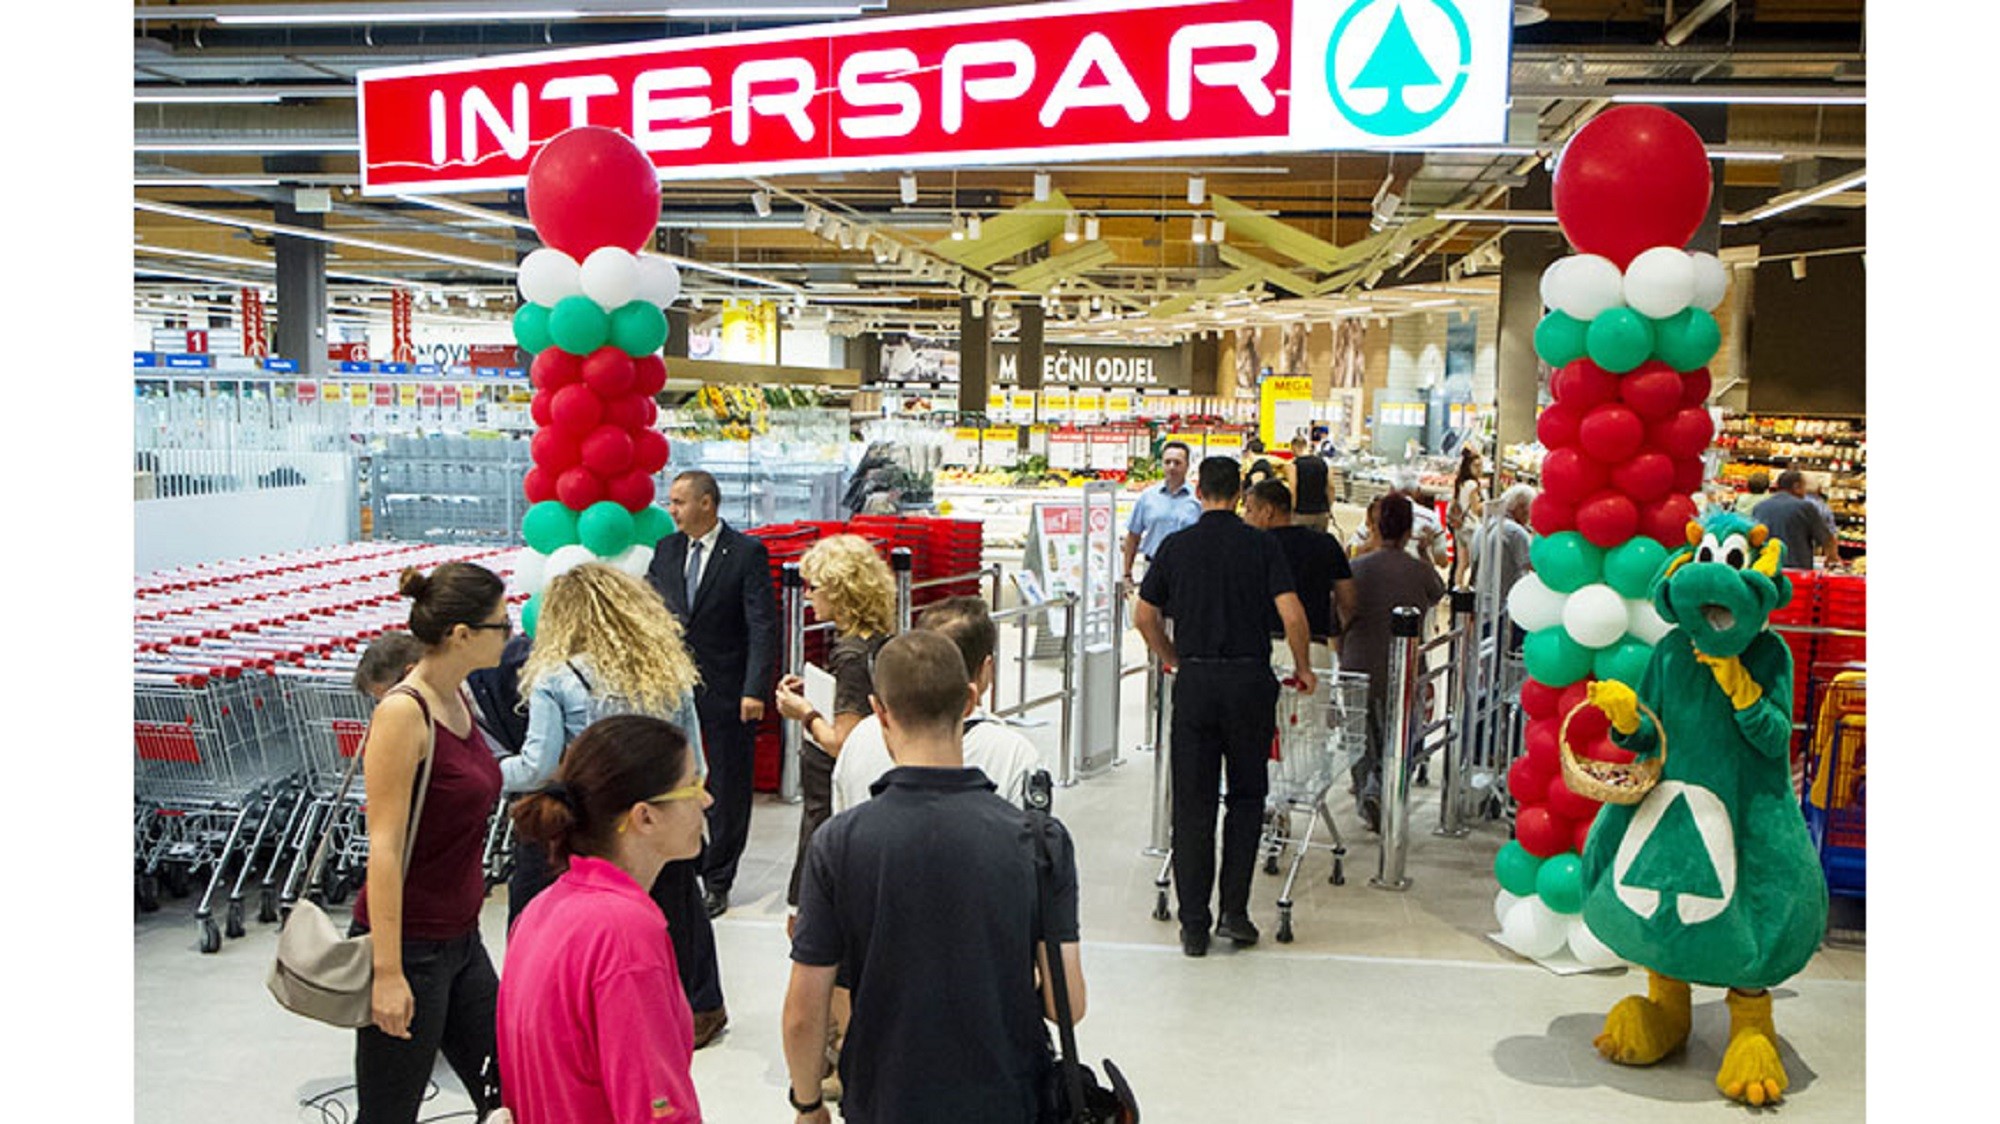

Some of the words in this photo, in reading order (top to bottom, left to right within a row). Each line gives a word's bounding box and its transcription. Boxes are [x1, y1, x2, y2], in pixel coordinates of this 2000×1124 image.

[430, 20, 1280, 165] INTERSPAR
[190, 331, 202, 351] 1
[1095, 357, 1158, 384] ODJEL
[1274, 380, 1312, 391] MEGA
